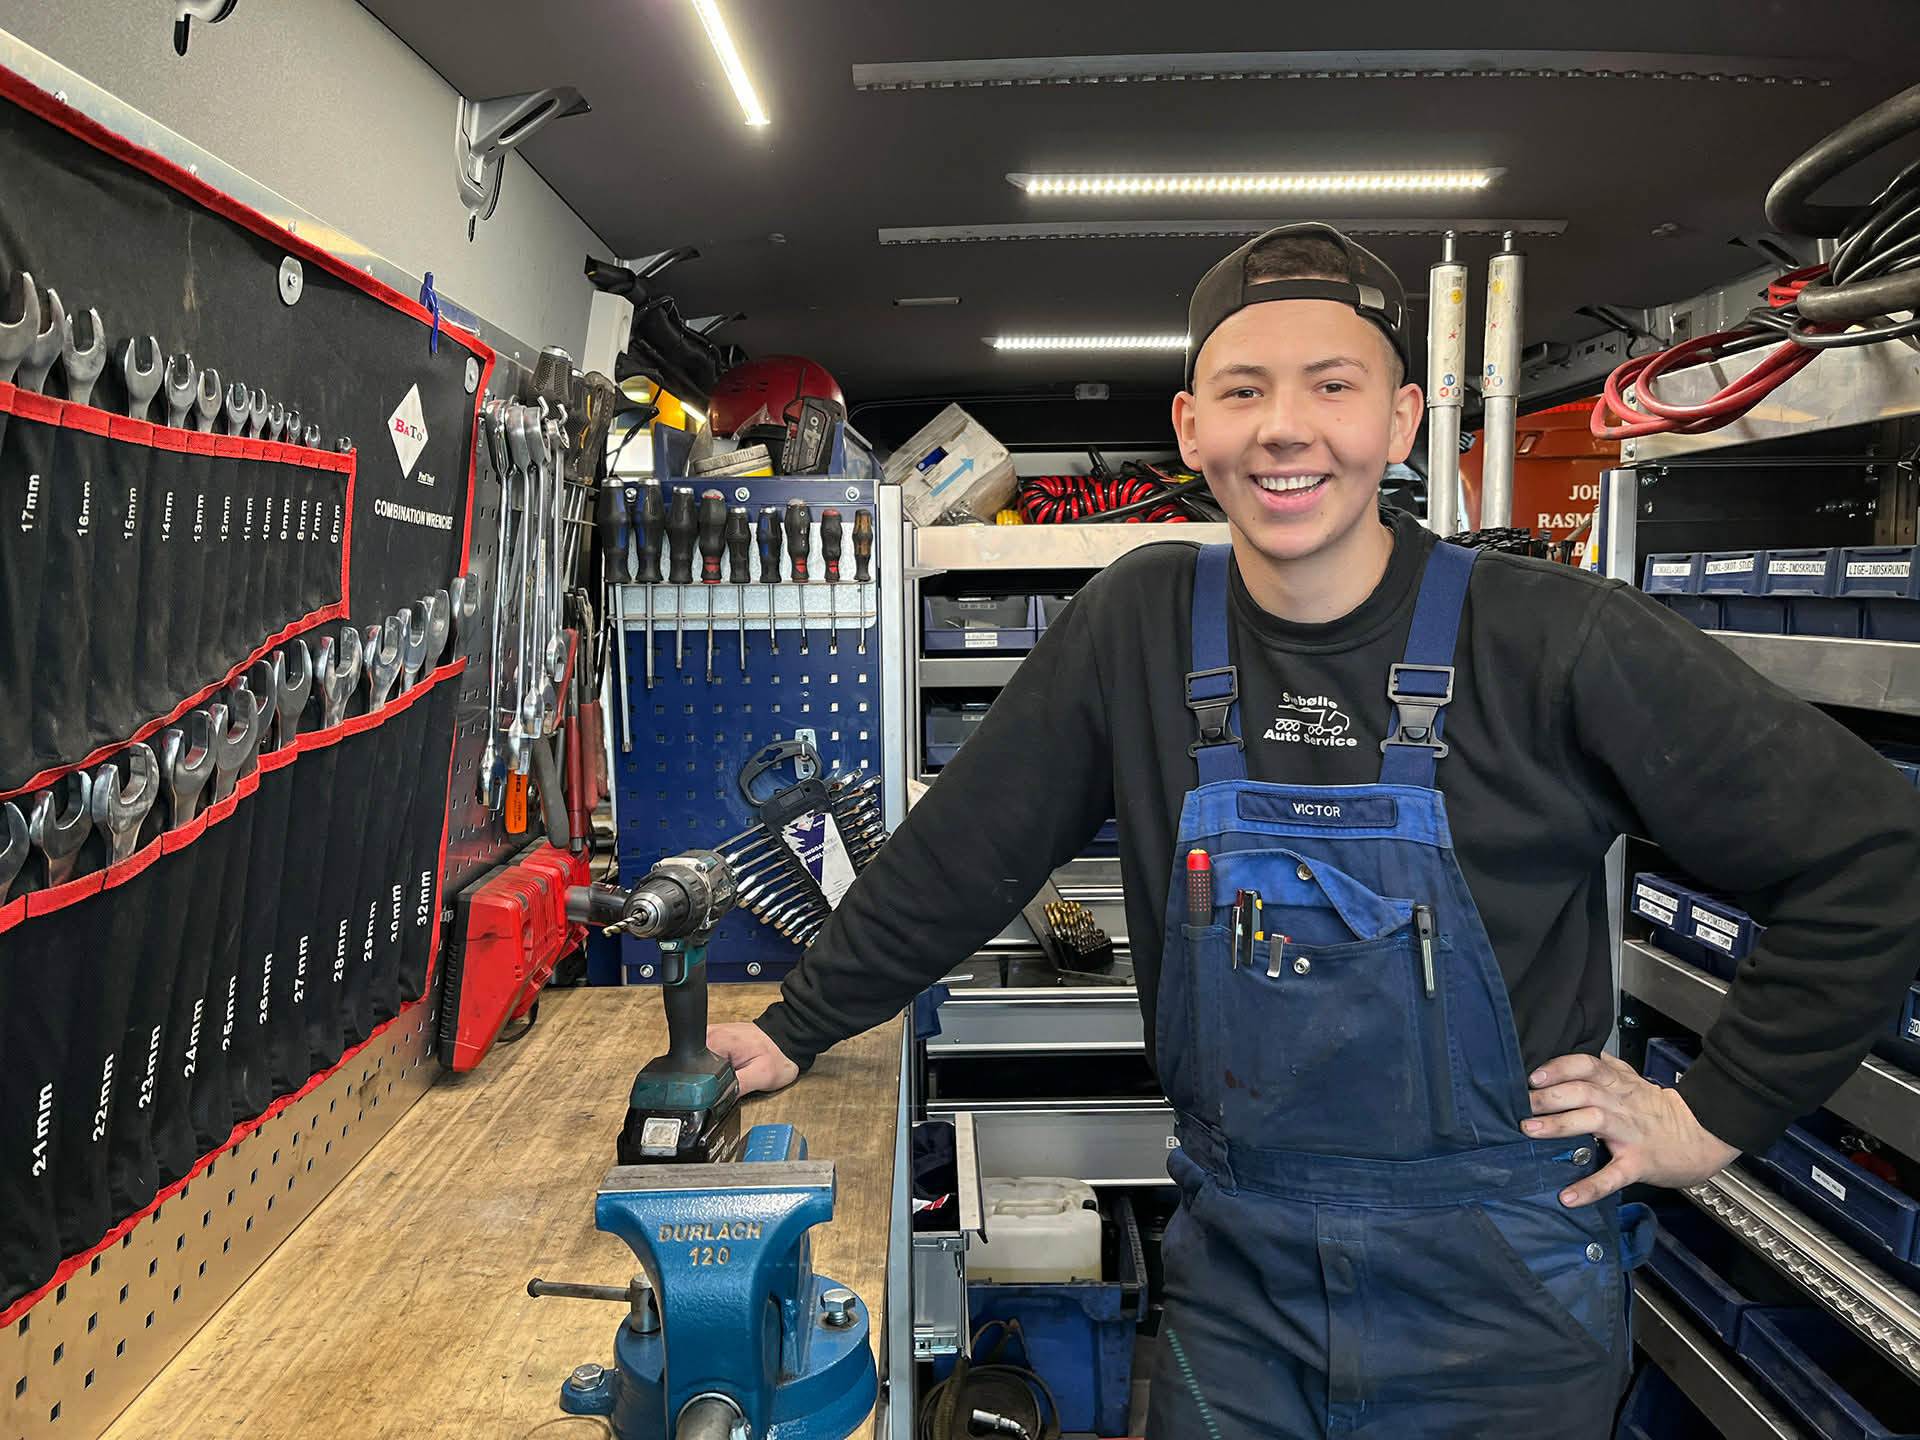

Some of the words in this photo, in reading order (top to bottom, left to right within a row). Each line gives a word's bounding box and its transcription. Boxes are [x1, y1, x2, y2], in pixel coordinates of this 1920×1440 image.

[20, 474, 41, 533] 17mm
[76, 480, 91, 537] 16mm
[123, 487, 137, 540] 15mm
[161, 491, 174, 542] 14mm
[193, 494, 205, 543] 13mm
[220, 495, 231, 542] 12mm
[243, 497, 254, 541] 11mm
[262, 497, 272, 541] 10mm
[296, 499, 308, 541] 8mm
[311, 501, 323, 542] 7mm
[330, 504, 341, 544] 6mm
[374, 498, 426, 526] COMBINATION
[1262, 727, 1301, 742] Auto
[1303, 733, 1358, 747] Service
[1292, 802, 1341, 818] VICTOR
[416, 870, 432, 926] 32mm
[333, 919, 348, 983] 28mm
[363, 901, 377, 962] 29mm
[259, 953, 273, 1025] 26mm
[293, 935, 309, 1003] 27mm
[183, 998, 204, 1078] 24mm
[222, 975, 237, 1051] 25mm
[138, 1024, 161, 1109] 23mm
[92, 1053, 115, 1142] 22mm
[32, 1082, 53, 1177] 21mm
[657, 1220, 764, 1243] DURLACH
[689, 1246, 731, 1267] 120
